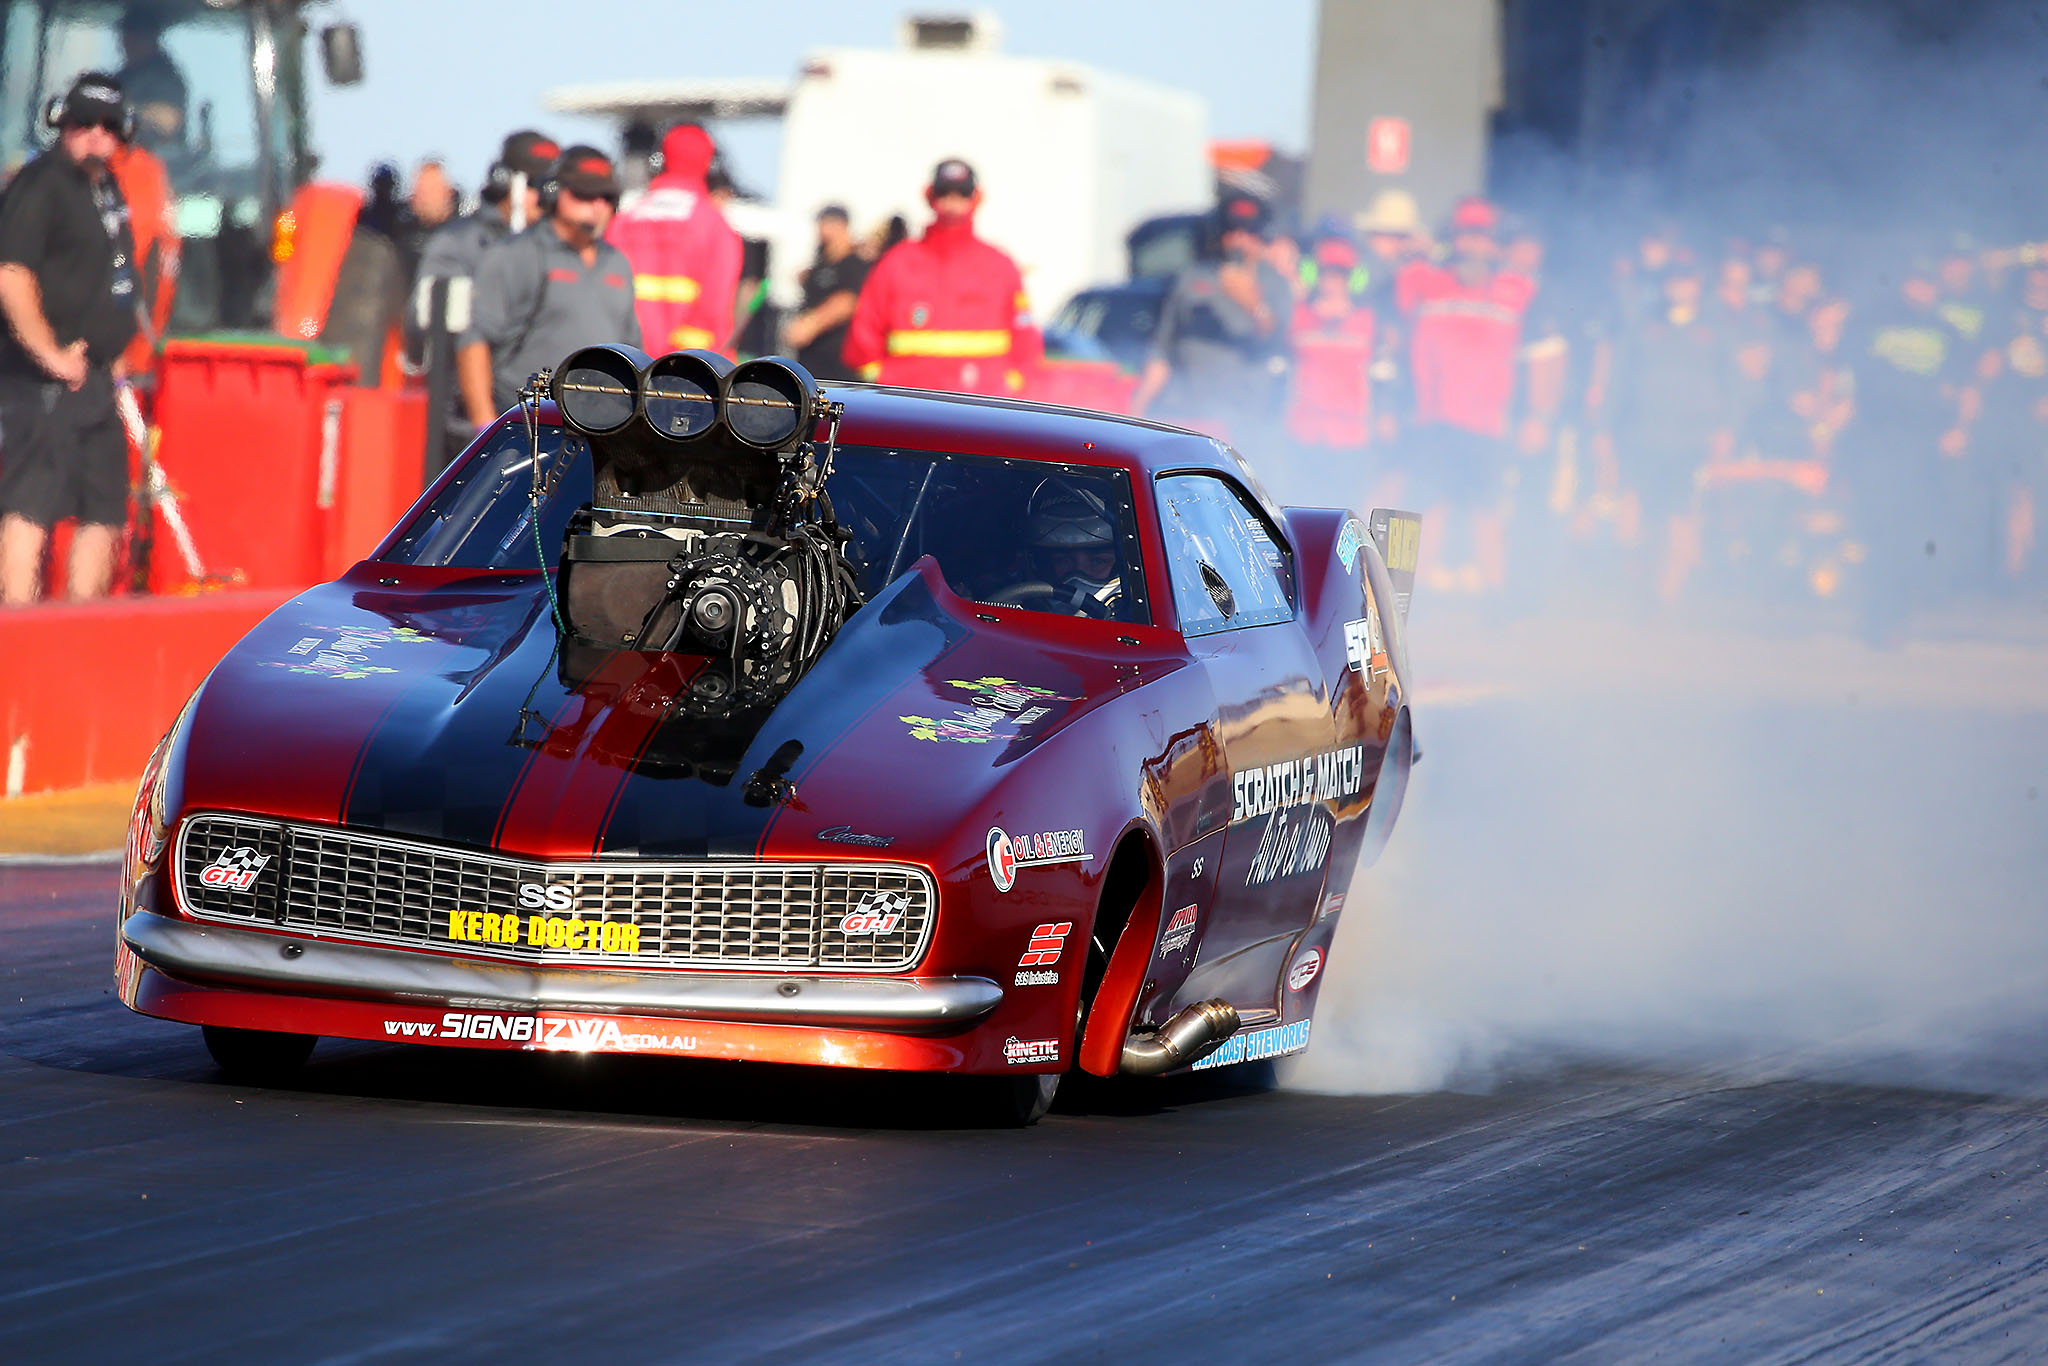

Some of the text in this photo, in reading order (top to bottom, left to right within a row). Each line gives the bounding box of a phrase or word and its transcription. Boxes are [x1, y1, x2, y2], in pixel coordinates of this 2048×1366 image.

[1233, 745, 1363, 821] SCRATCH & MATCH
[1013, 828, 1085, 860] OIL & ENERGY
[203, 868, 253, 887] GT-1
[1191, 856, 1204, 879] SS
[519, 883, 573, 910] SS
[448, 909, 641, 953] KERB DOCTOR
[844, 915, 896, 931] GT-1
[1008, 1040, 1059, 1057] KINETIC
[1246, 1019, 1311, 1062] SITEWORKS
